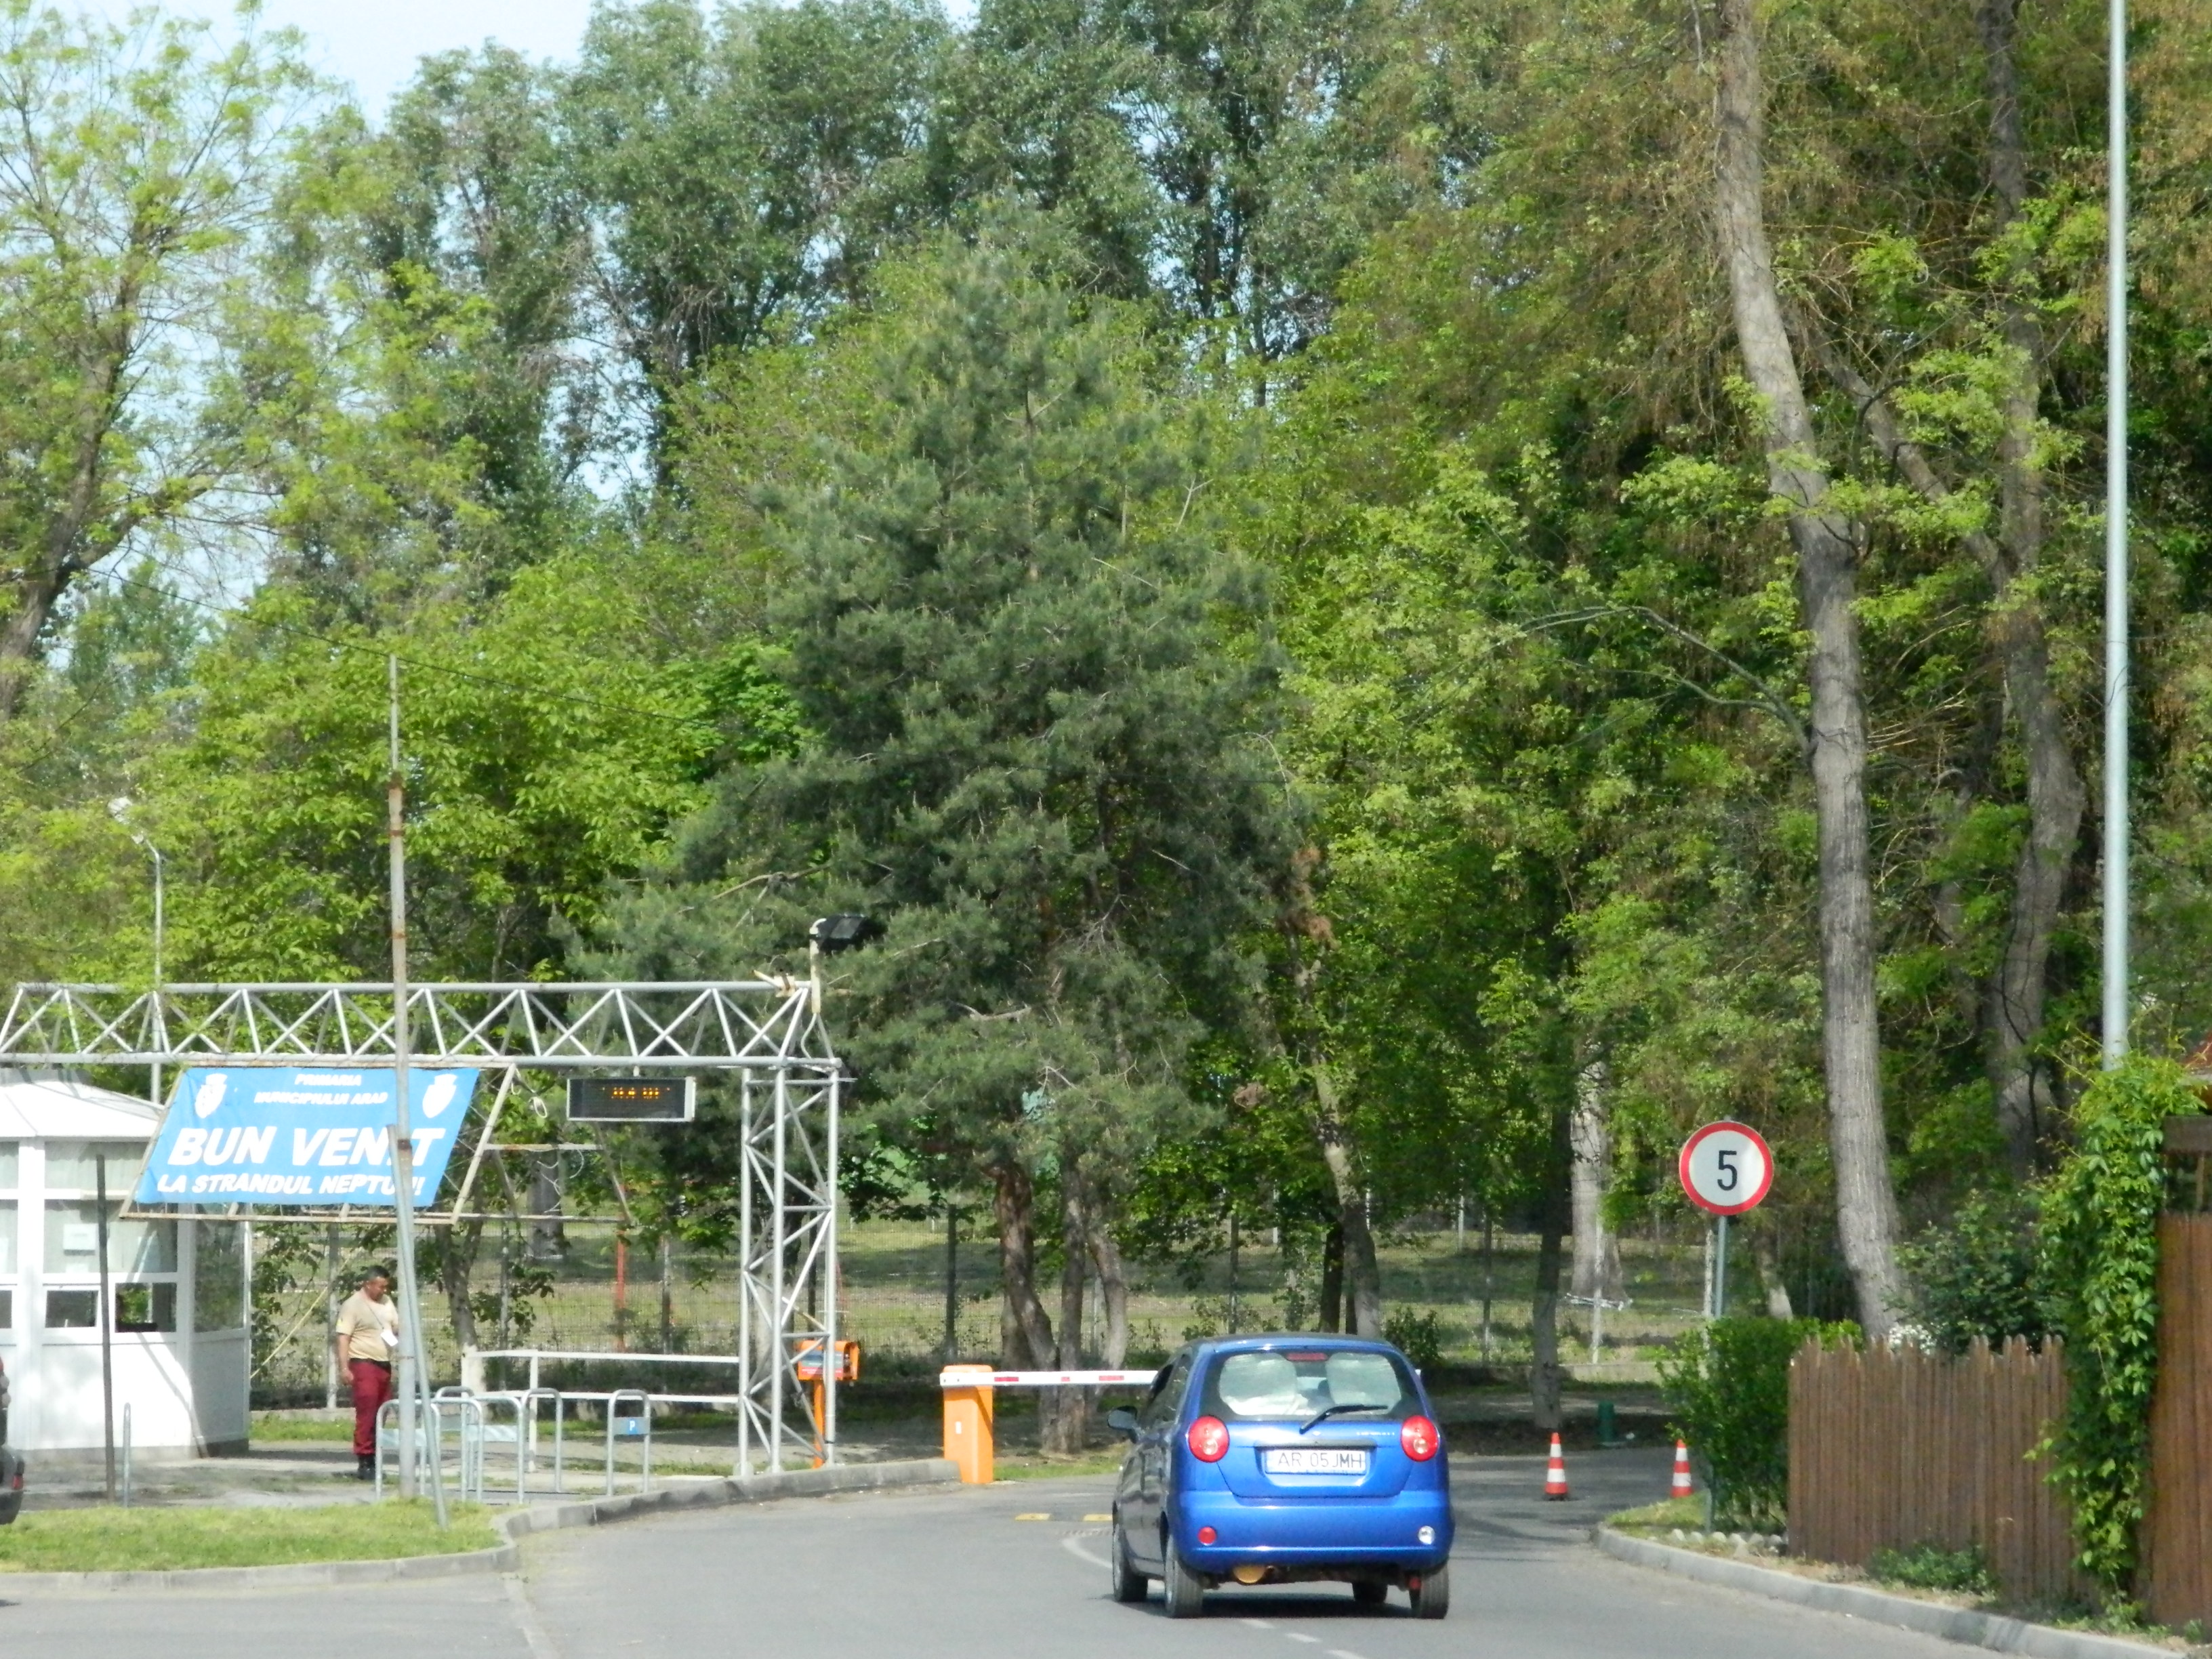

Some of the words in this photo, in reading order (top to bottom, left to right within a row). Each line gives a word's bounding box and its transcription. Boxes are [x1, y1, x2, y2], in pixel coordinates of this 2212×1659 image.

[350, 1092, 388, 1105] ARAD
[167, 1126, 277, 1166] BUN
[292, 1127, 446, 1166] VENT
[1717, 1150, 1738, 1191] 5
[157, 1174, 187, 1193] LA
[191, 1172, 313, 1195] STRANDUL
[319, 1174, 426, 1195] NEPTU!
[1278, 1452, 1302, 1467] AR
[1309, 1452, 1329, 1468] 05
[1332, 1453, 1362, 1469] JMH
